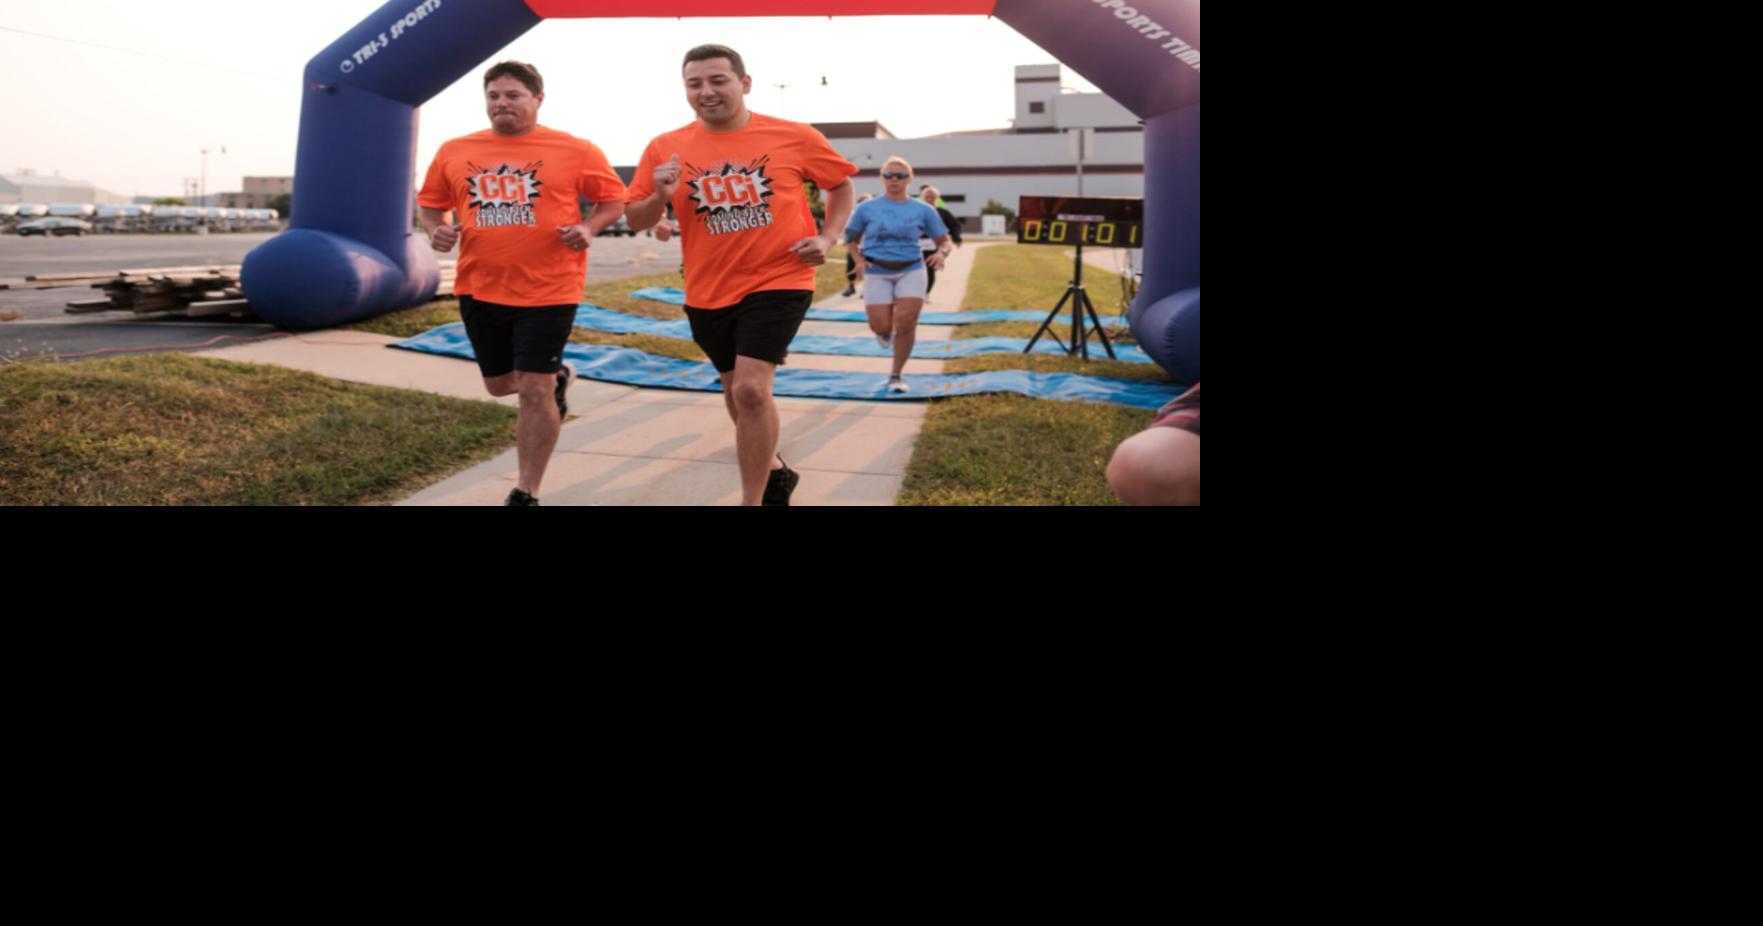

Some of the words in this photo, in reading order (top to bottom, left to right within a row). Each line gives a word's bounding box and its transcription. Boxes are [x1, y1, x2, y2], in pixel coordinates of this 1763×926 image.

[352, 32, 389, 65] TRI-S
[390, 0, 442, 39] SPORTS
[1092, 0, 1171, 40] PORTS
[476, 212, 537, 229] STRONGER
[706, 212, 773, 236] STRONGER
